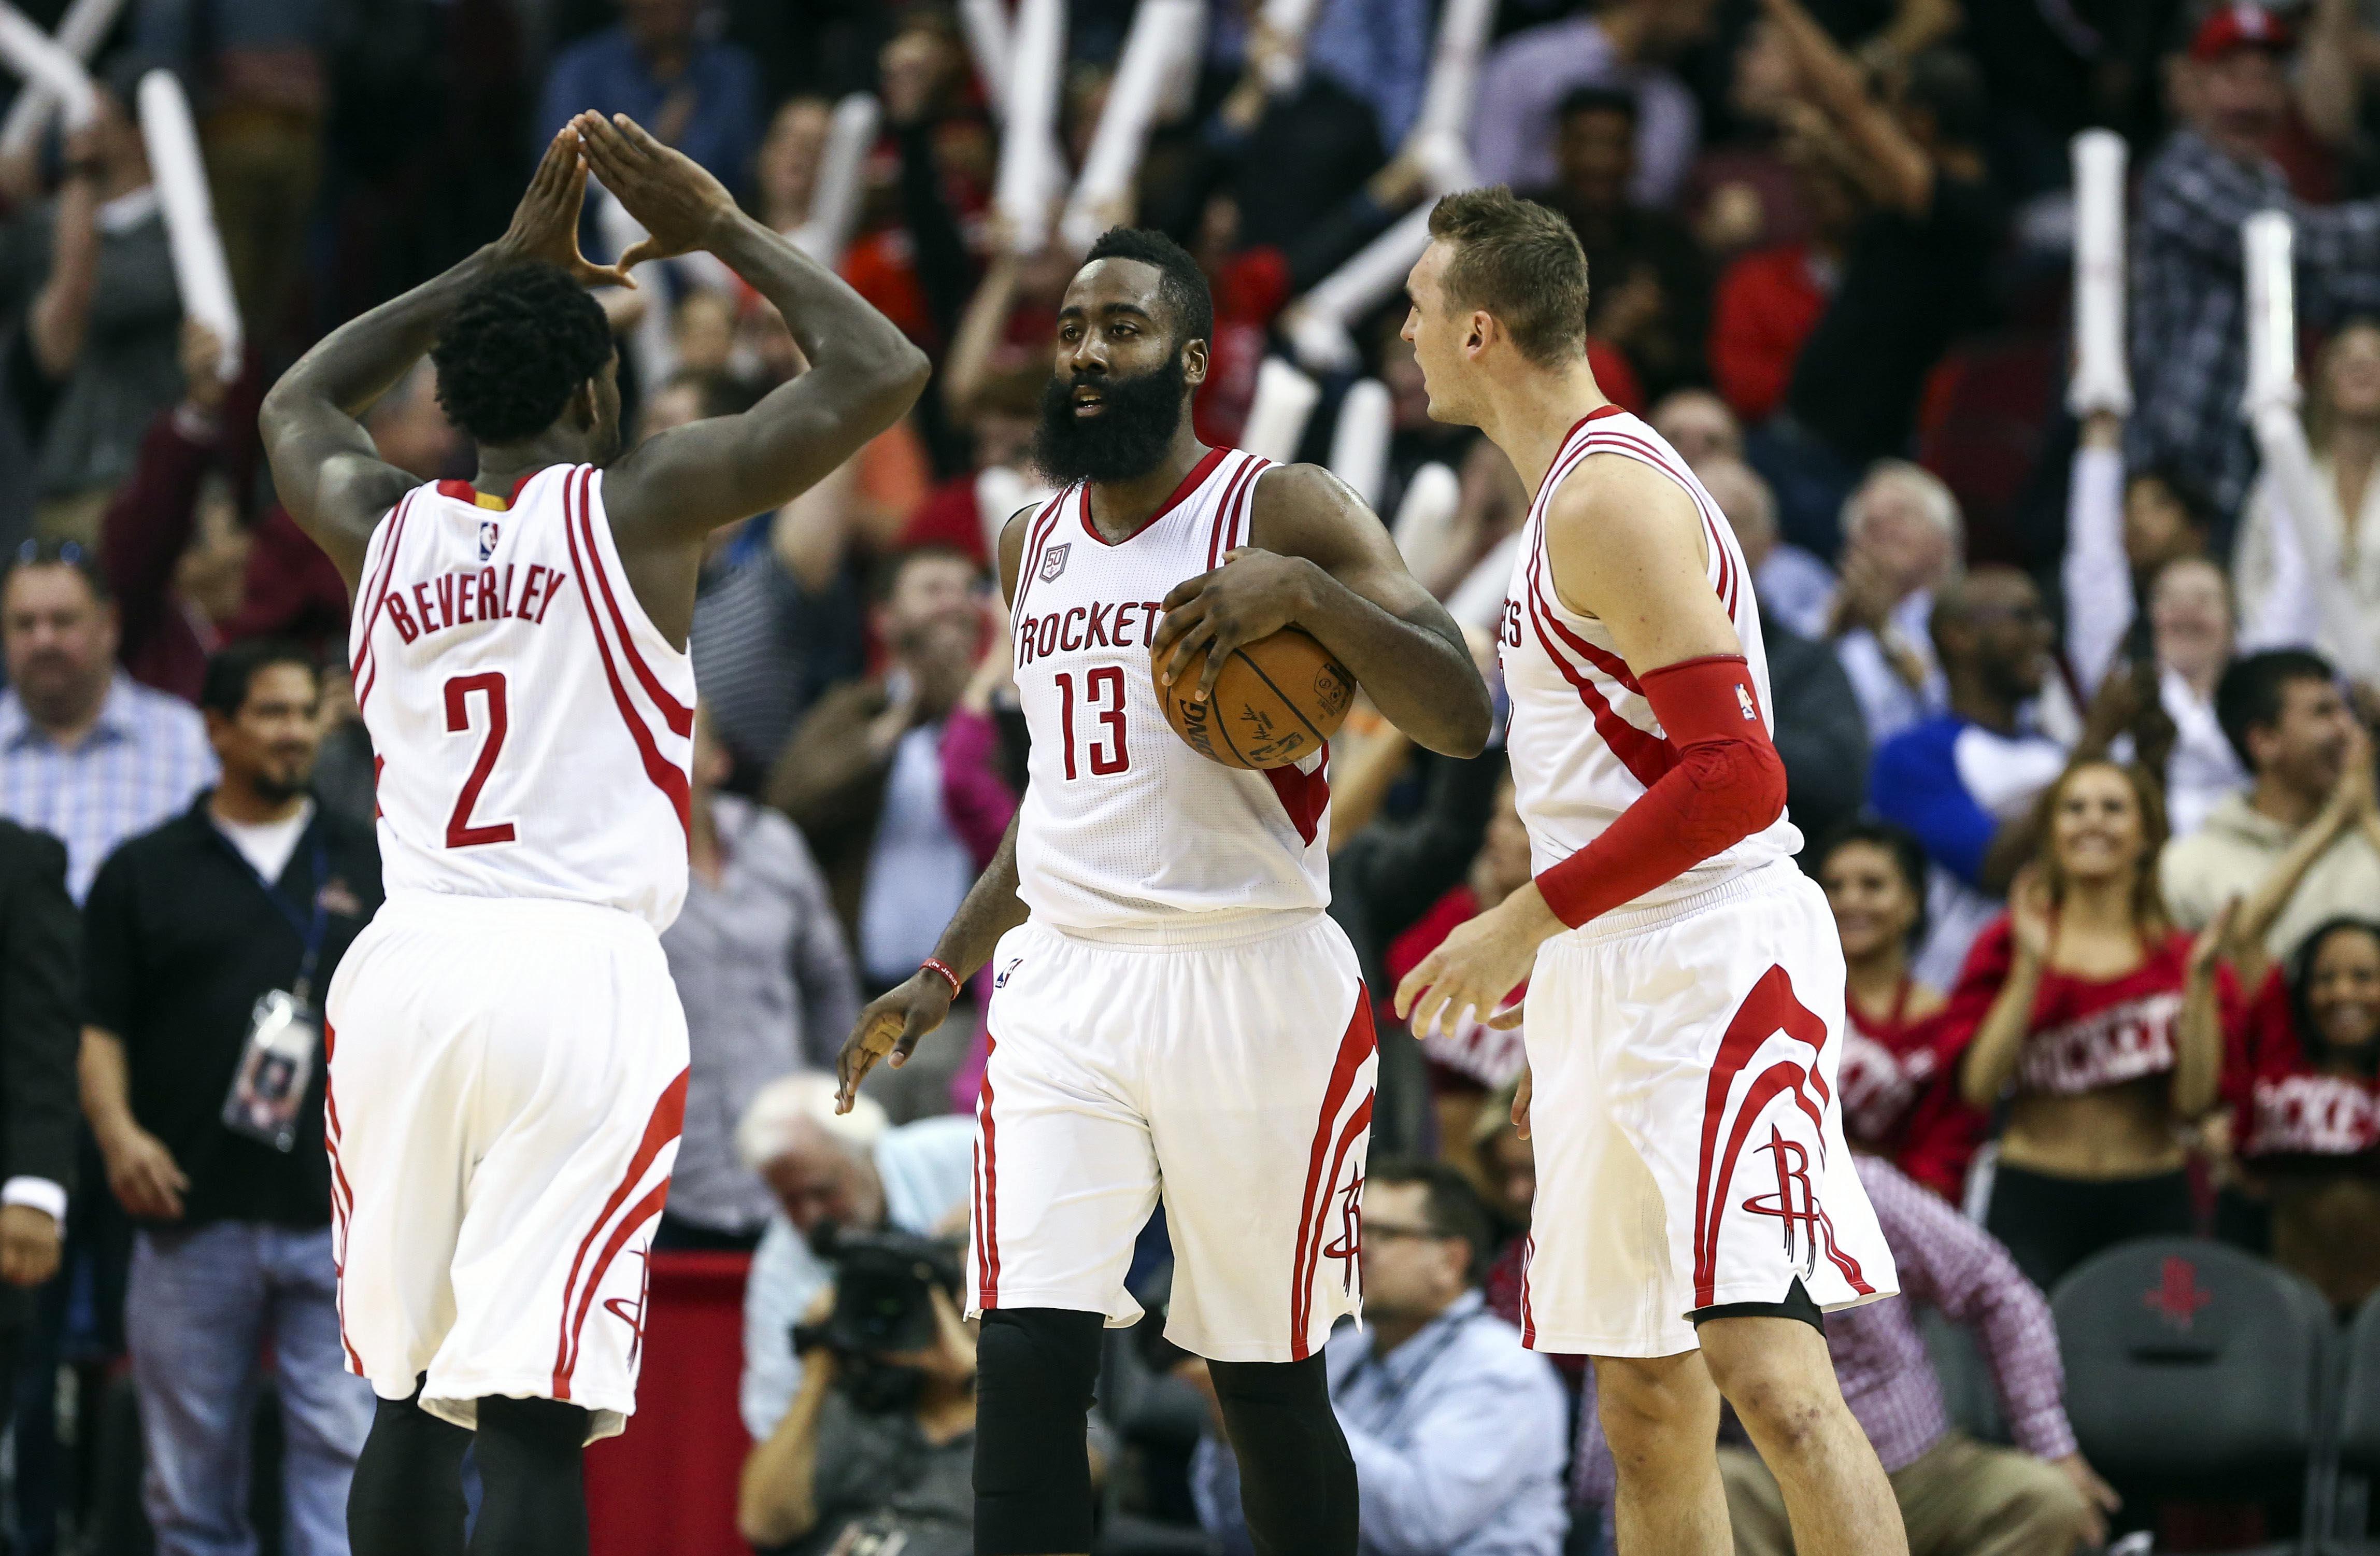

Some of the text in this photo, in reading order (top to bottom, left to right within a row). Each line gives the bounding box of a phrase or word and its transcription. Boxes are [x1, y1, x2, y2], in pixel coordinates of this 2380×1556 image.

[1046, 549, 1063, 568] 50
[383, 563, 566, 645] BEVERLEY
[1019, 601, 1161, 670] ROCKET
[444, 671, 516, 848] 2
[1054, 665, 1130, 781] 13
